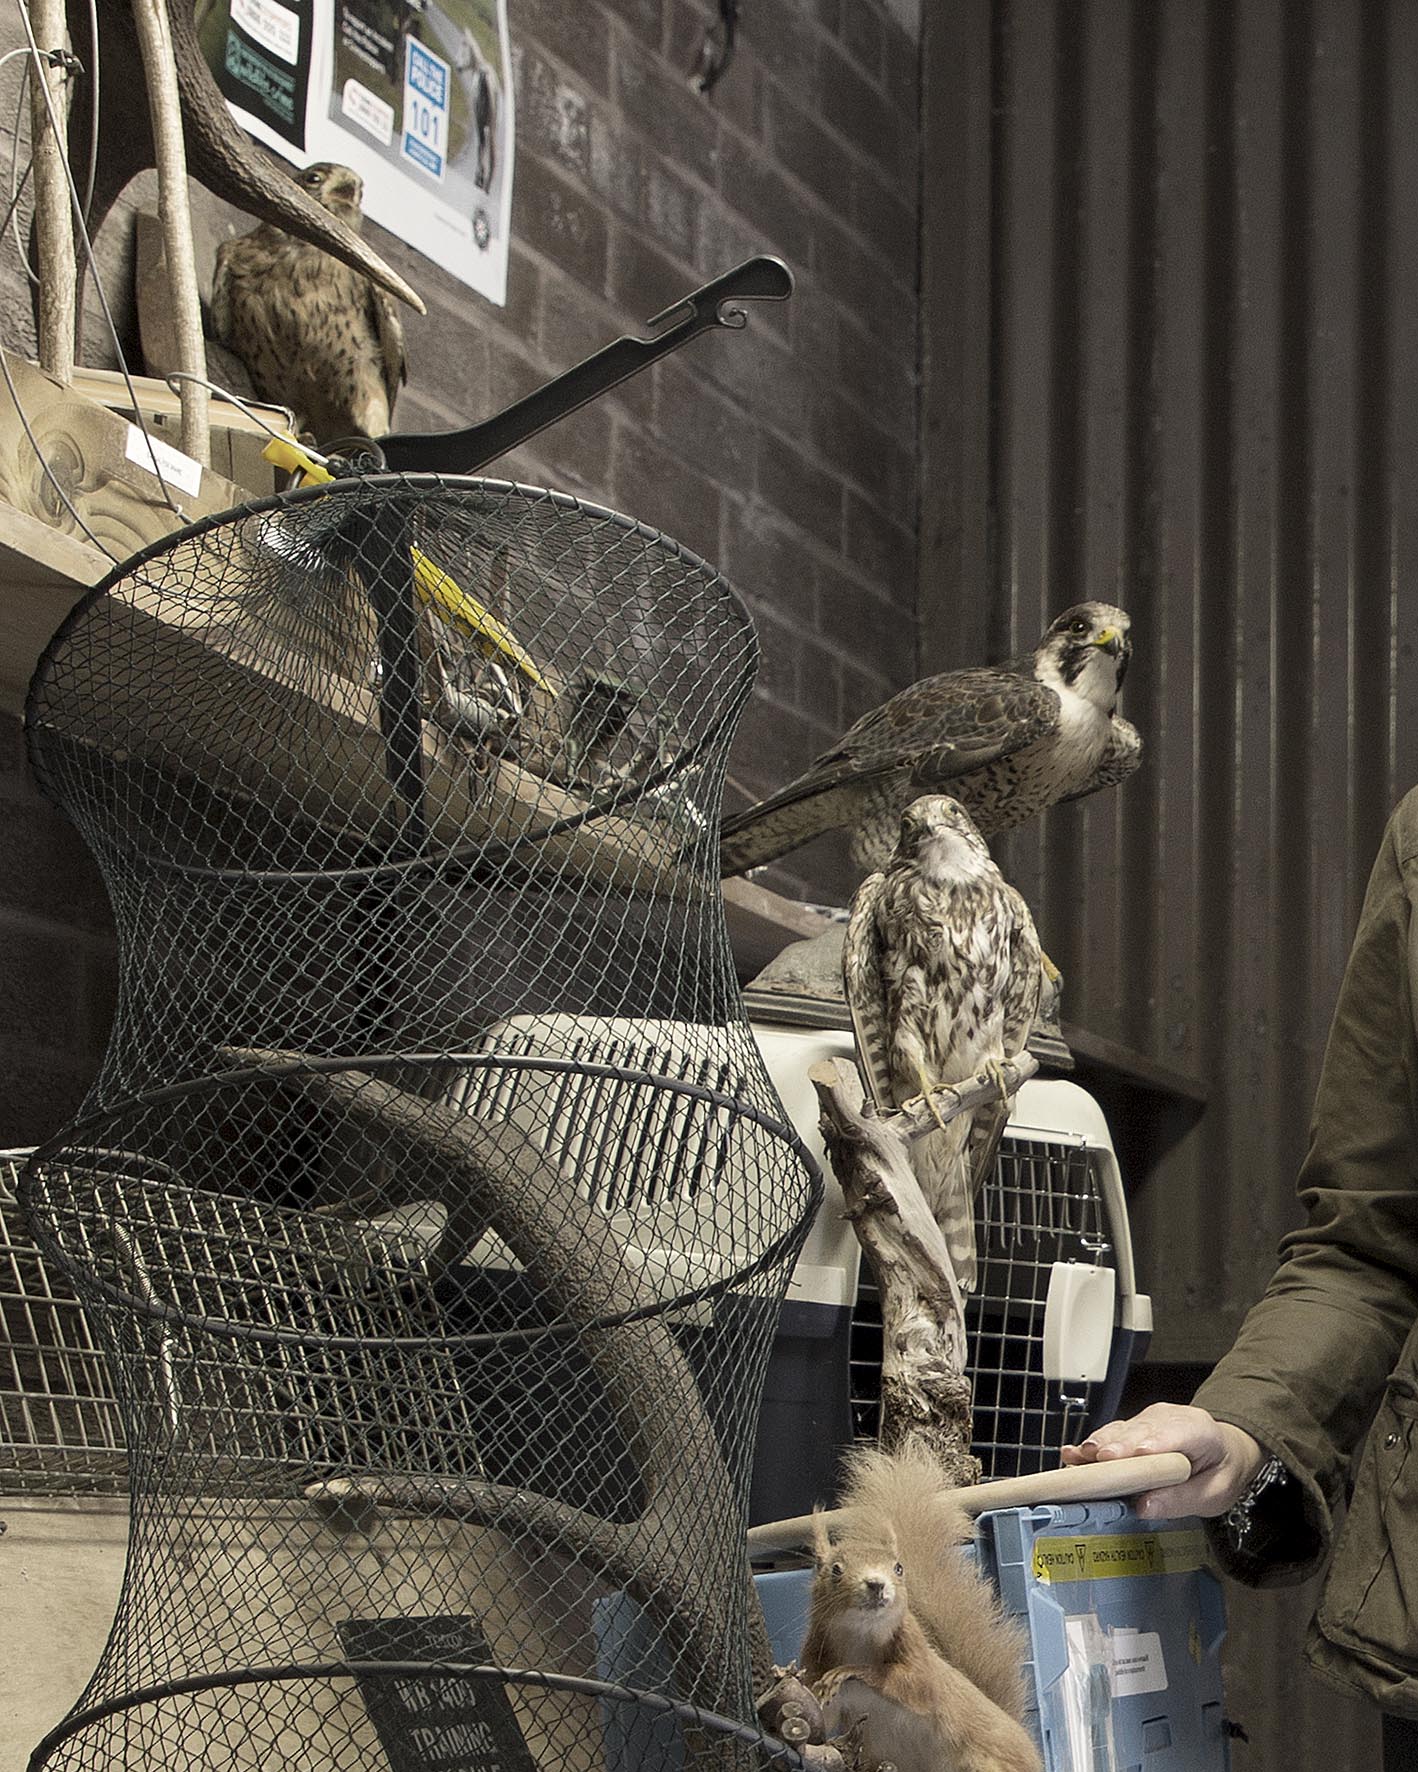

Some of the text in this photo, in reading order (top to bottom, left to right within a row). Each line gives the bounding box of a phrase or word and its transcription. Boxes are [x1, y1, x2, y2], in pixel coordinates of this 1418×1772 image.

[411, 65, 445, 103] POLICE
[412, 100, 439, 145] 101
[408, 1721, 498, 1761] TRAINING
